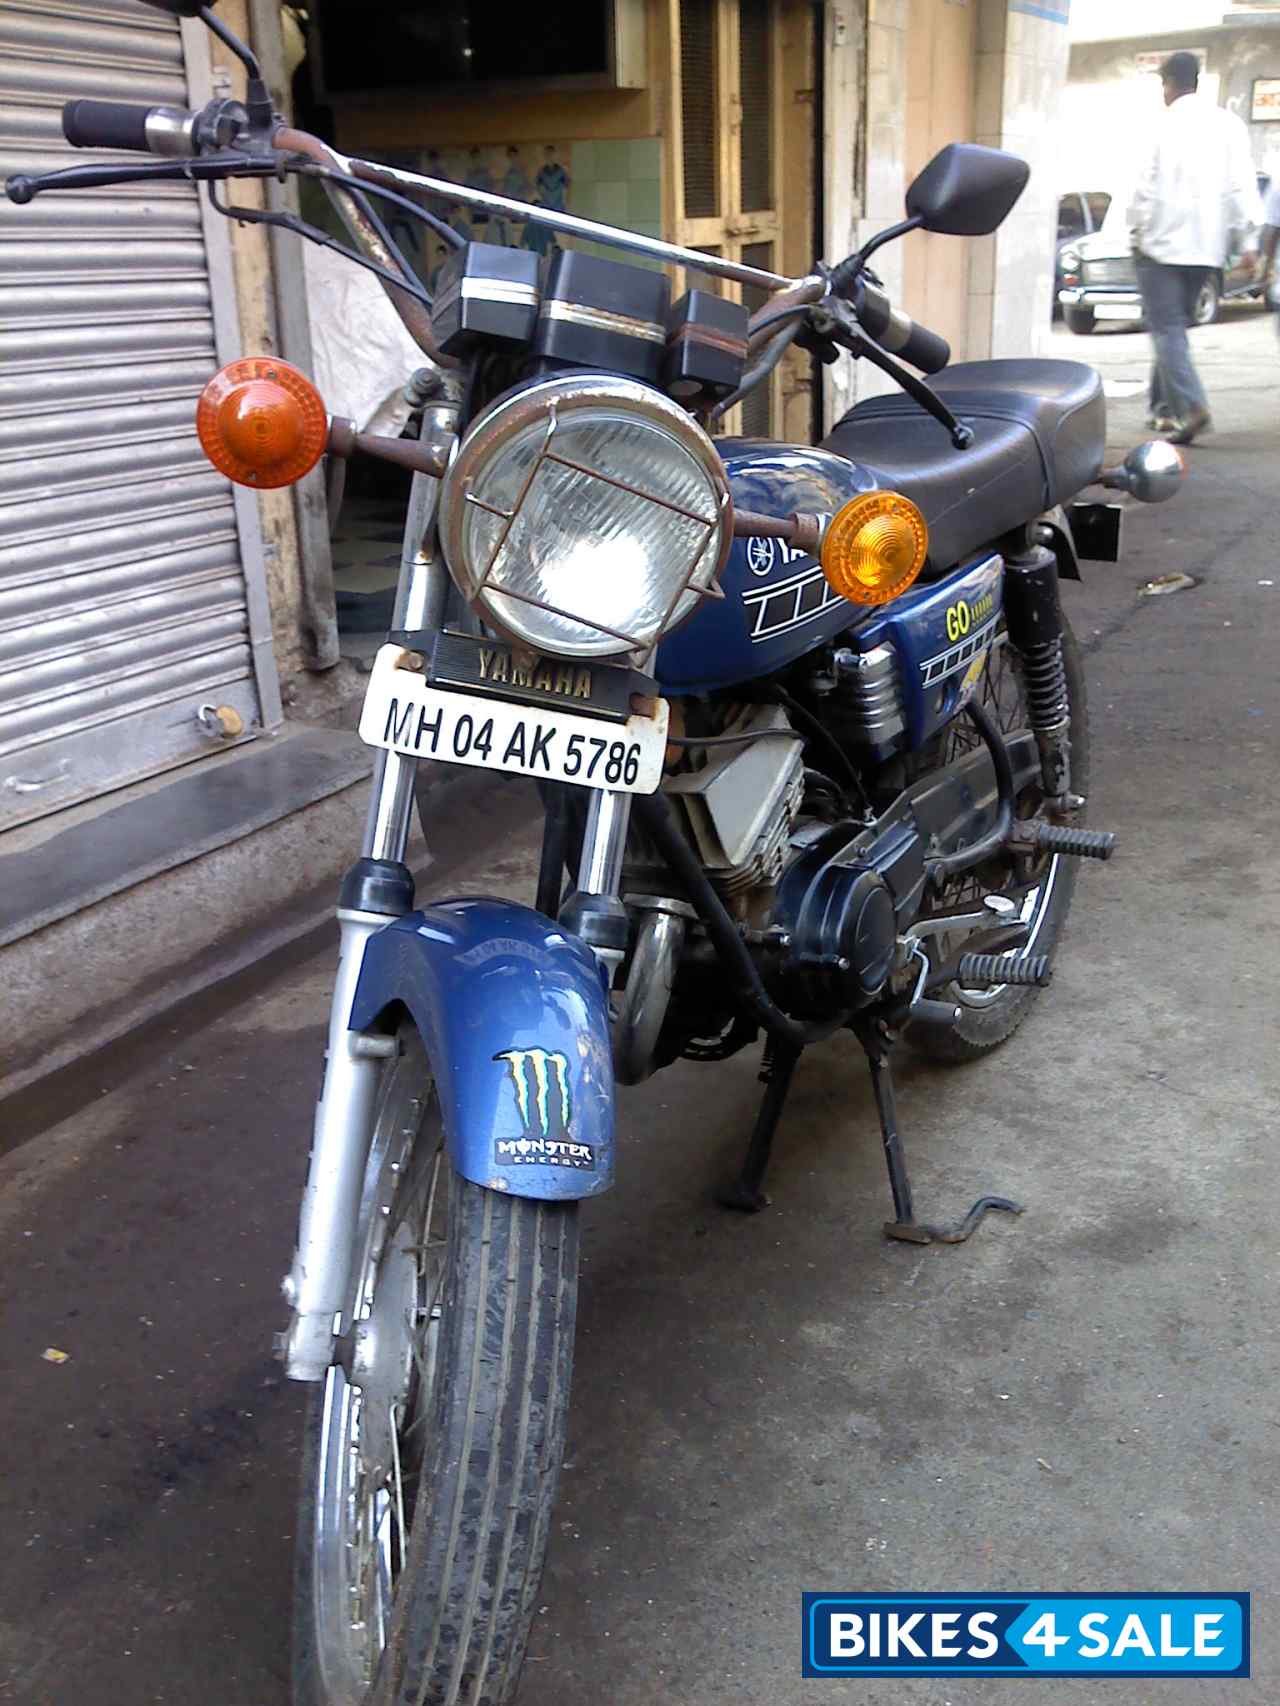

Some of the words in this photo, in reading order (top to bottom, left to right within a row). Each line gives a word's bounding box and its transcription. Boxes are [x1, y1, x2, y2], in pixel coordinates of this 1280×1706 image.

[946, 600, 970, 642] GO
[479, 647, 592, 698] YAMAHA
[383, 697, 444, 752] MH
[453, 713, 494, 761] 04
[502, 721, 557, 771] AK
[563, 734, 642, 786] 5786
[497, 1137, 593, 1161] MONSTER
